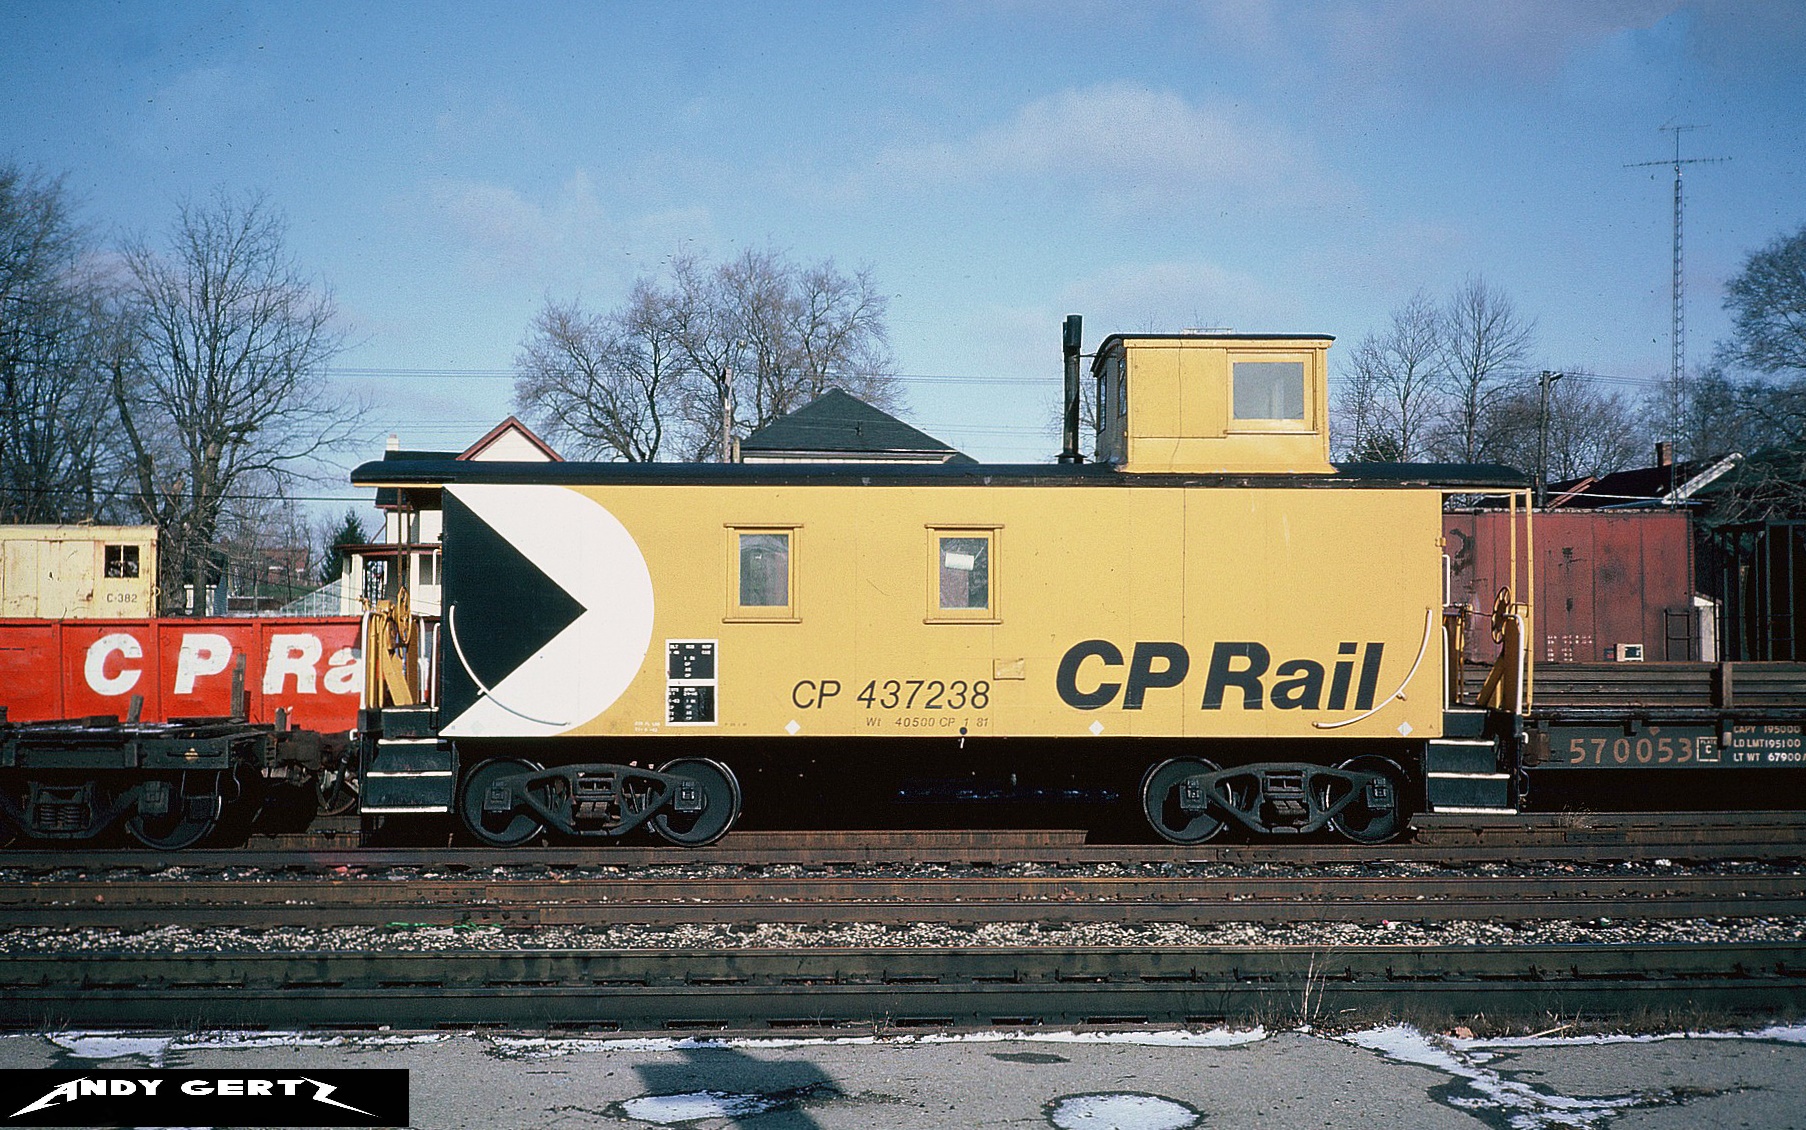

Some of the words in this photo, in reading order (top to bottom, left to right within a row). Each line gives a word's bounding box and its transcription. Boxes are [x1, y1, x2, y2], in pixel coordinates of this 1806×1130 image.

[263, 633, 361, 695] Ra
[1056, 639, 1190, 710] CP
[1201, 641, 1385, 710] Rail
[792, 680, 841, 709] CP
[856, 680, 990, 709] 437238
[866, 717, 882, 727] Wt
[895, 717, 935, 727] 40500
[939, 717, 956, 728] CP
[1733, 725, 1756, 733] CAPY
[1764, 725, 1801, 733] 195000
[1733, 739, 1745, 748] LD
[1747, 739, 1765, 748] LMT
[1765, 739, 1801, 748] 195100
[1569, 738, 1693, 764] 570053
[1705, 745, 1712, 754] C
[1733, 753, 1744, 762] LT
[1747, 753, 1760, 762] WT
[1768, 752, 1801, 762] 67900
